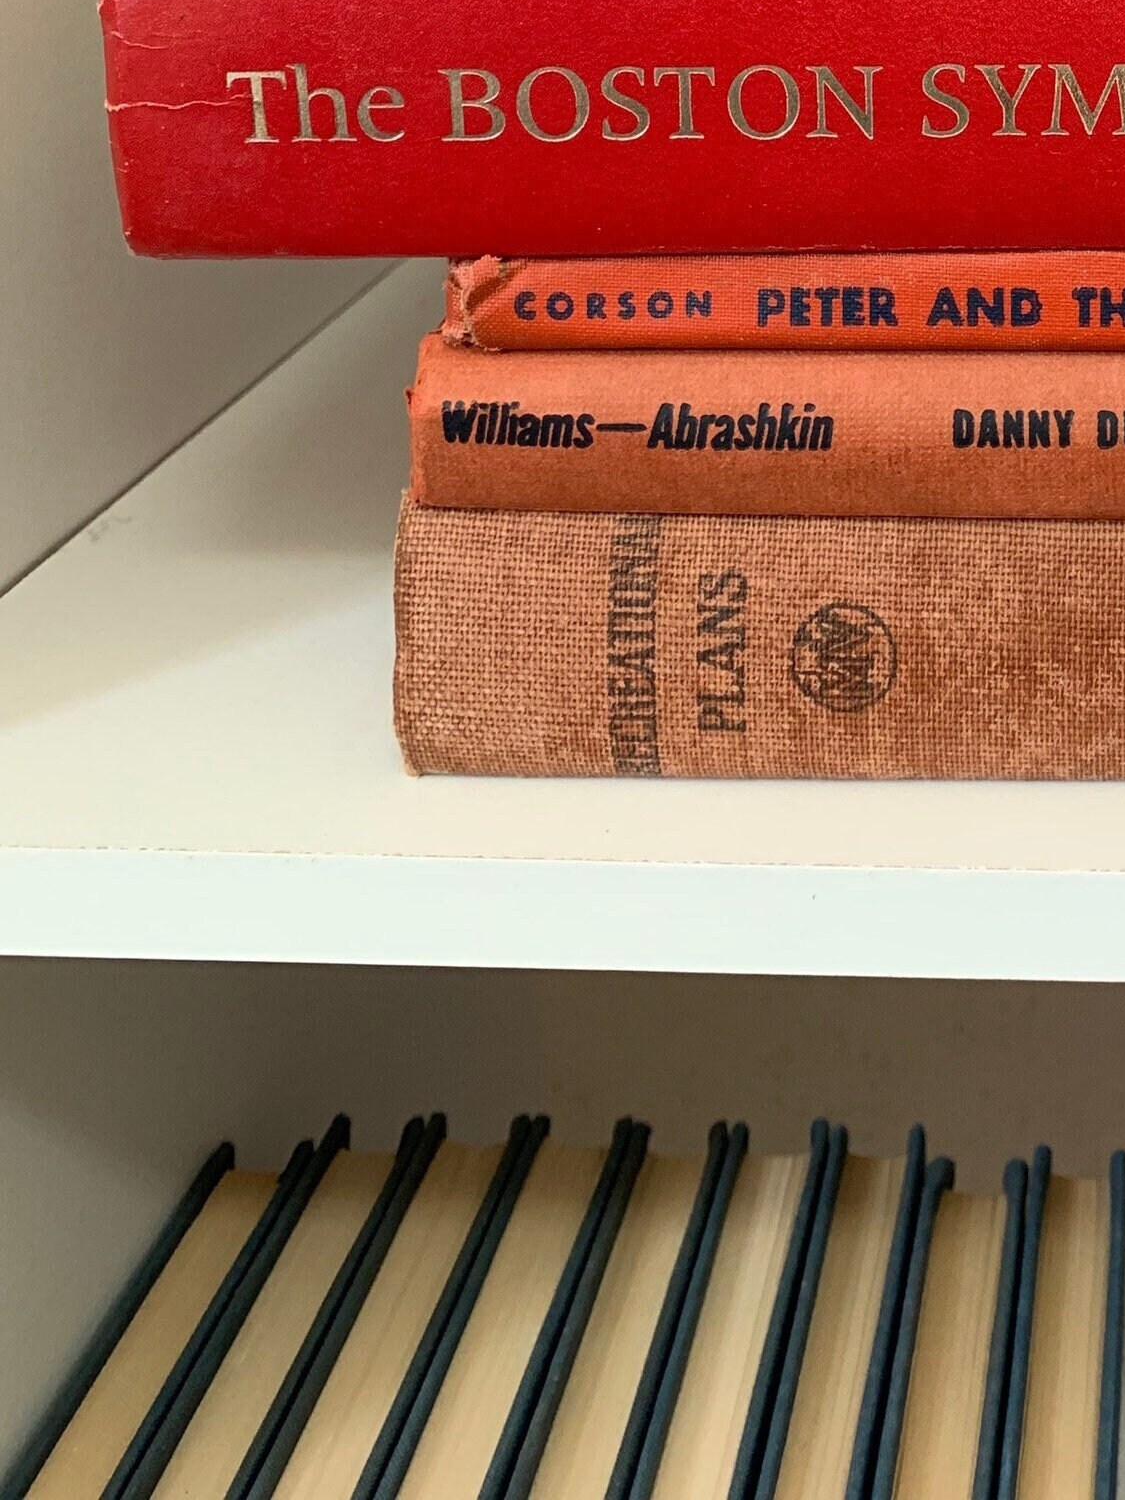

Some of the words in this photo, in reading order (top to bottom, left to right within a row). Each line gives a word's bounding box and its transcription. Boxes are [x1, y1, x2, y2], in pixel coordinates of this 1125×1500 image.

[226, 62, 405, 143] The
[437, 65, 884, 142] BOSTON
[513, 289, 714, 322] CORSON
[756, 286, 899, 328] PETER
[926, 286, 1044, 328] AND
[951, 407, 1077, 450] DANNY
[697, 566, 750, 734] PLANS
